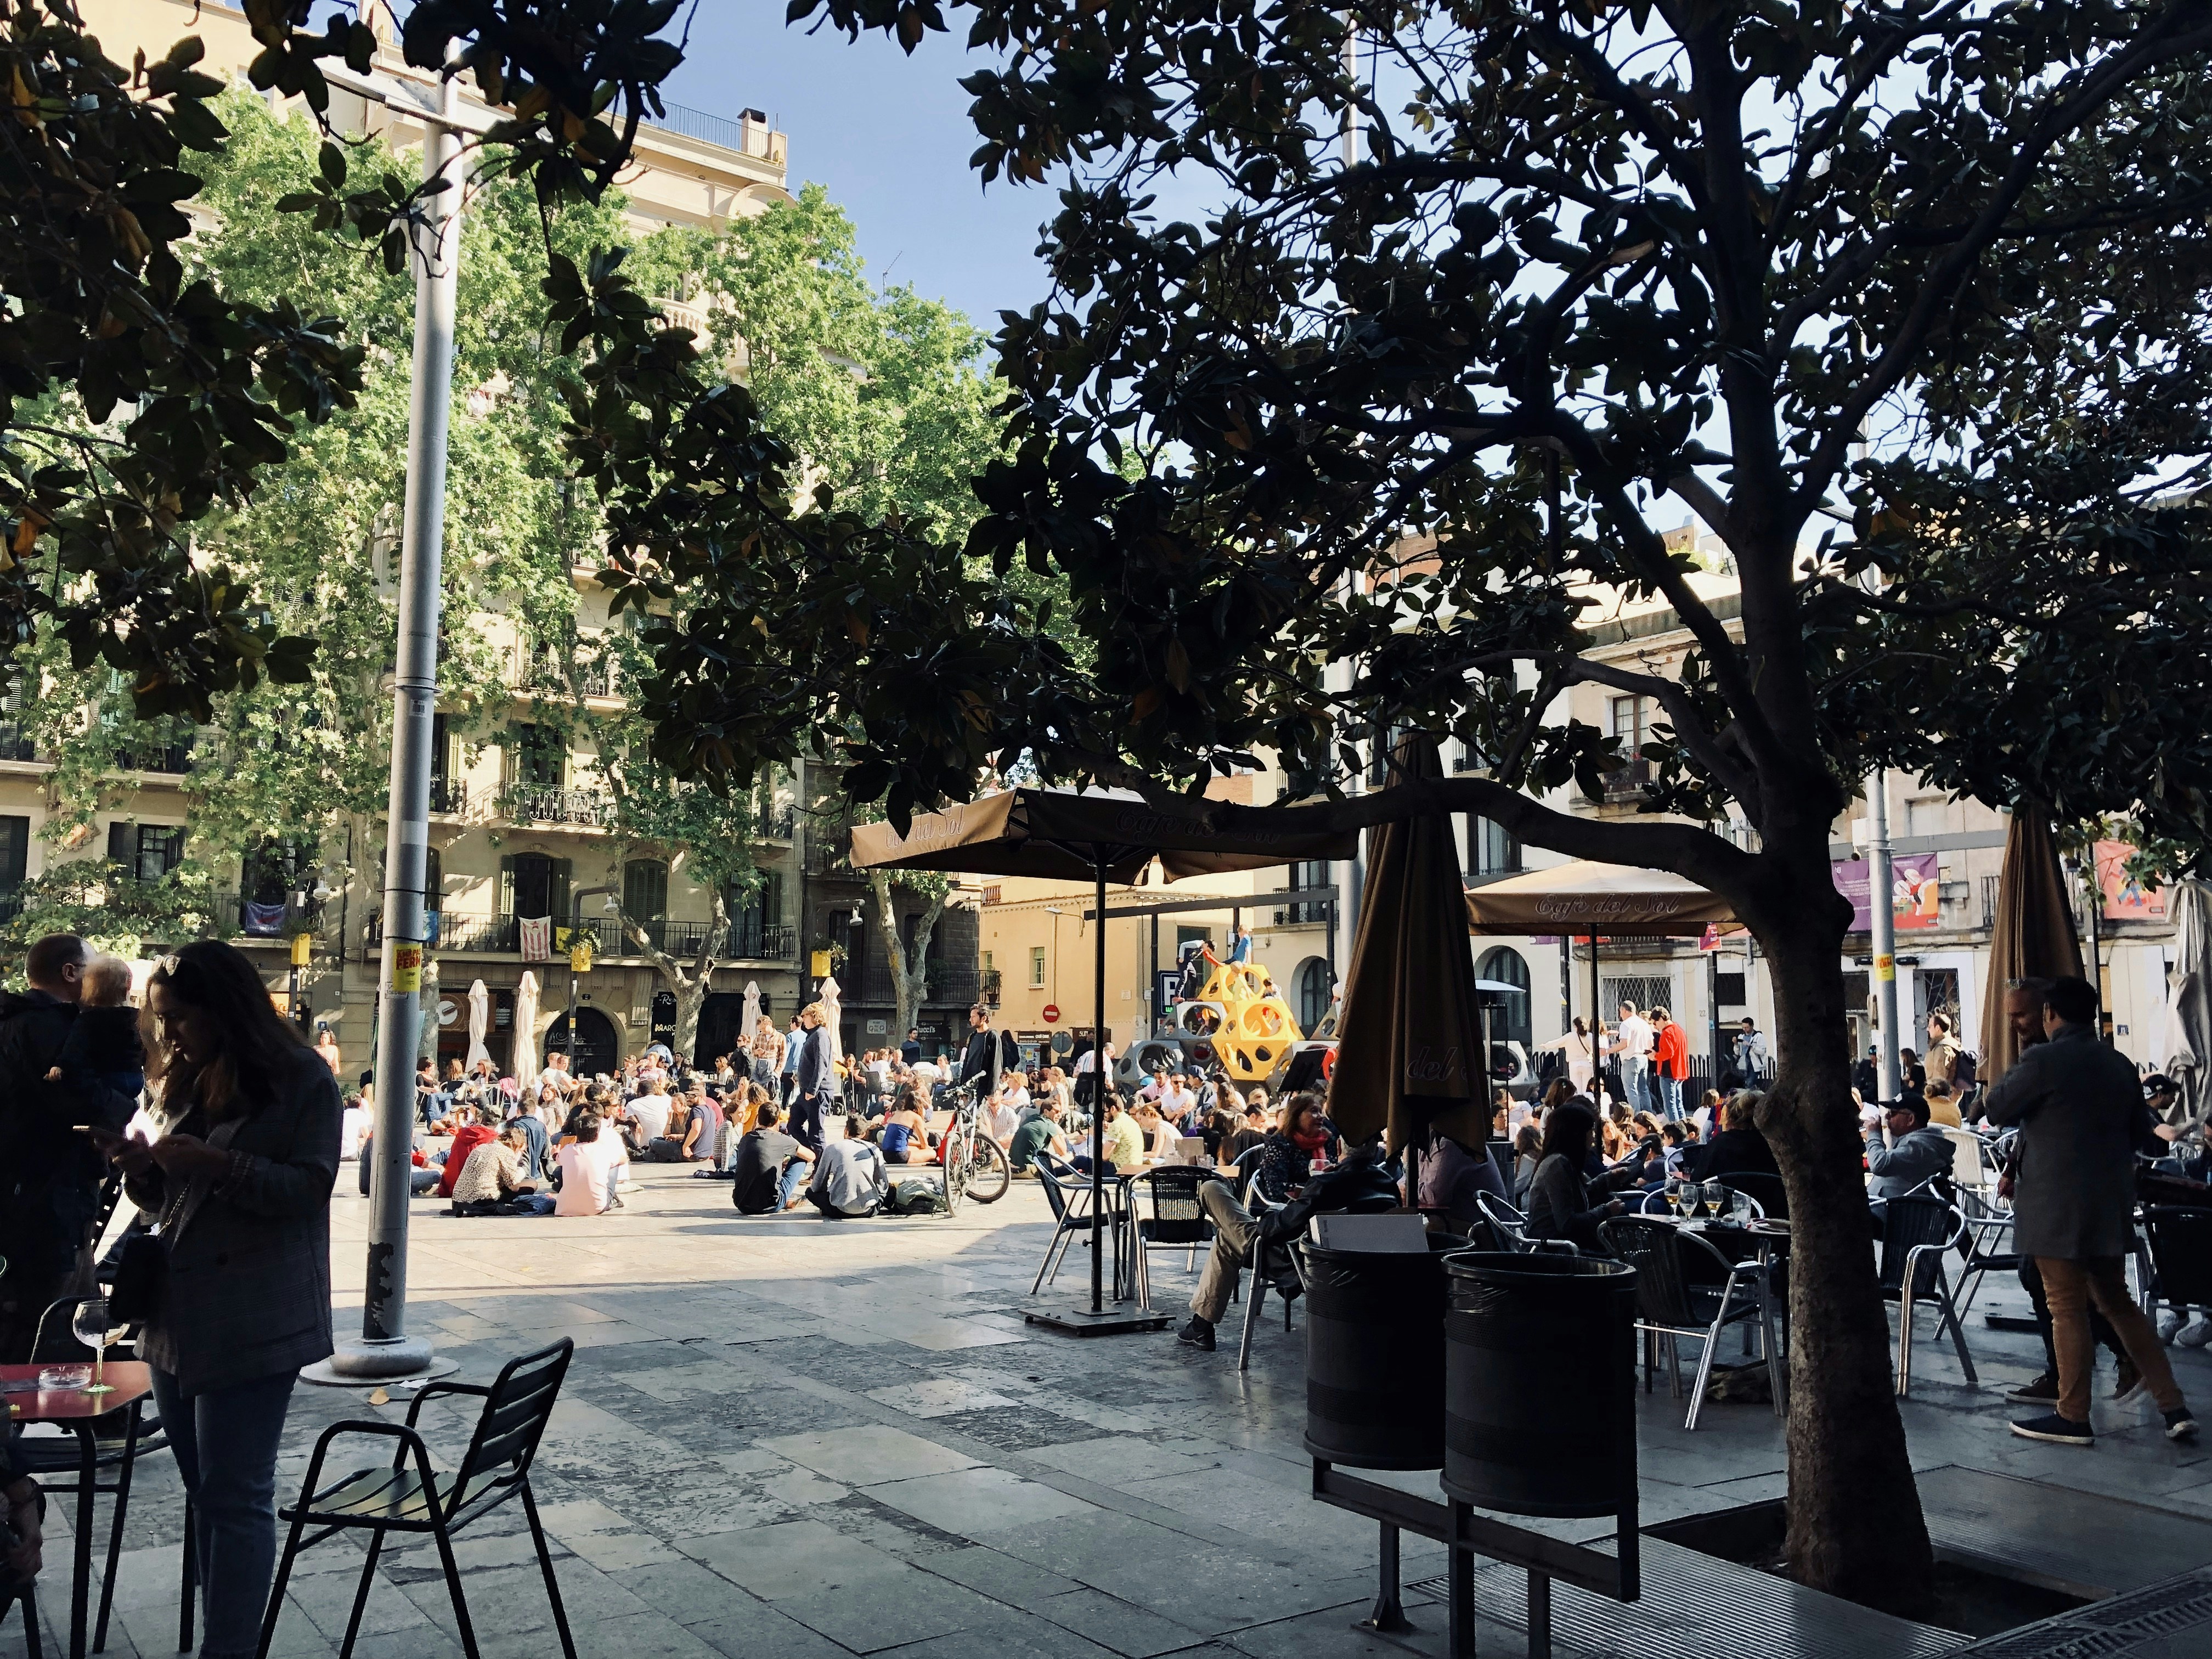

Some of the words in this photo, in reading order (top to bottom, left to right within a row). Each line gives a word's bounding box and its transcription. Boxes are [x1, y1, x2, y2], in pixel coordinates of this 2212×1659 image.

[915, 812, 935, 842] del
[938, 806, 966, 837] Sol
[1593, 893, 1634, 913] del
[1635, 893, 1683, 914] Sol
[1164, 977, 1180, 1006] P
[1407, 1046, 1458, 1081] del
